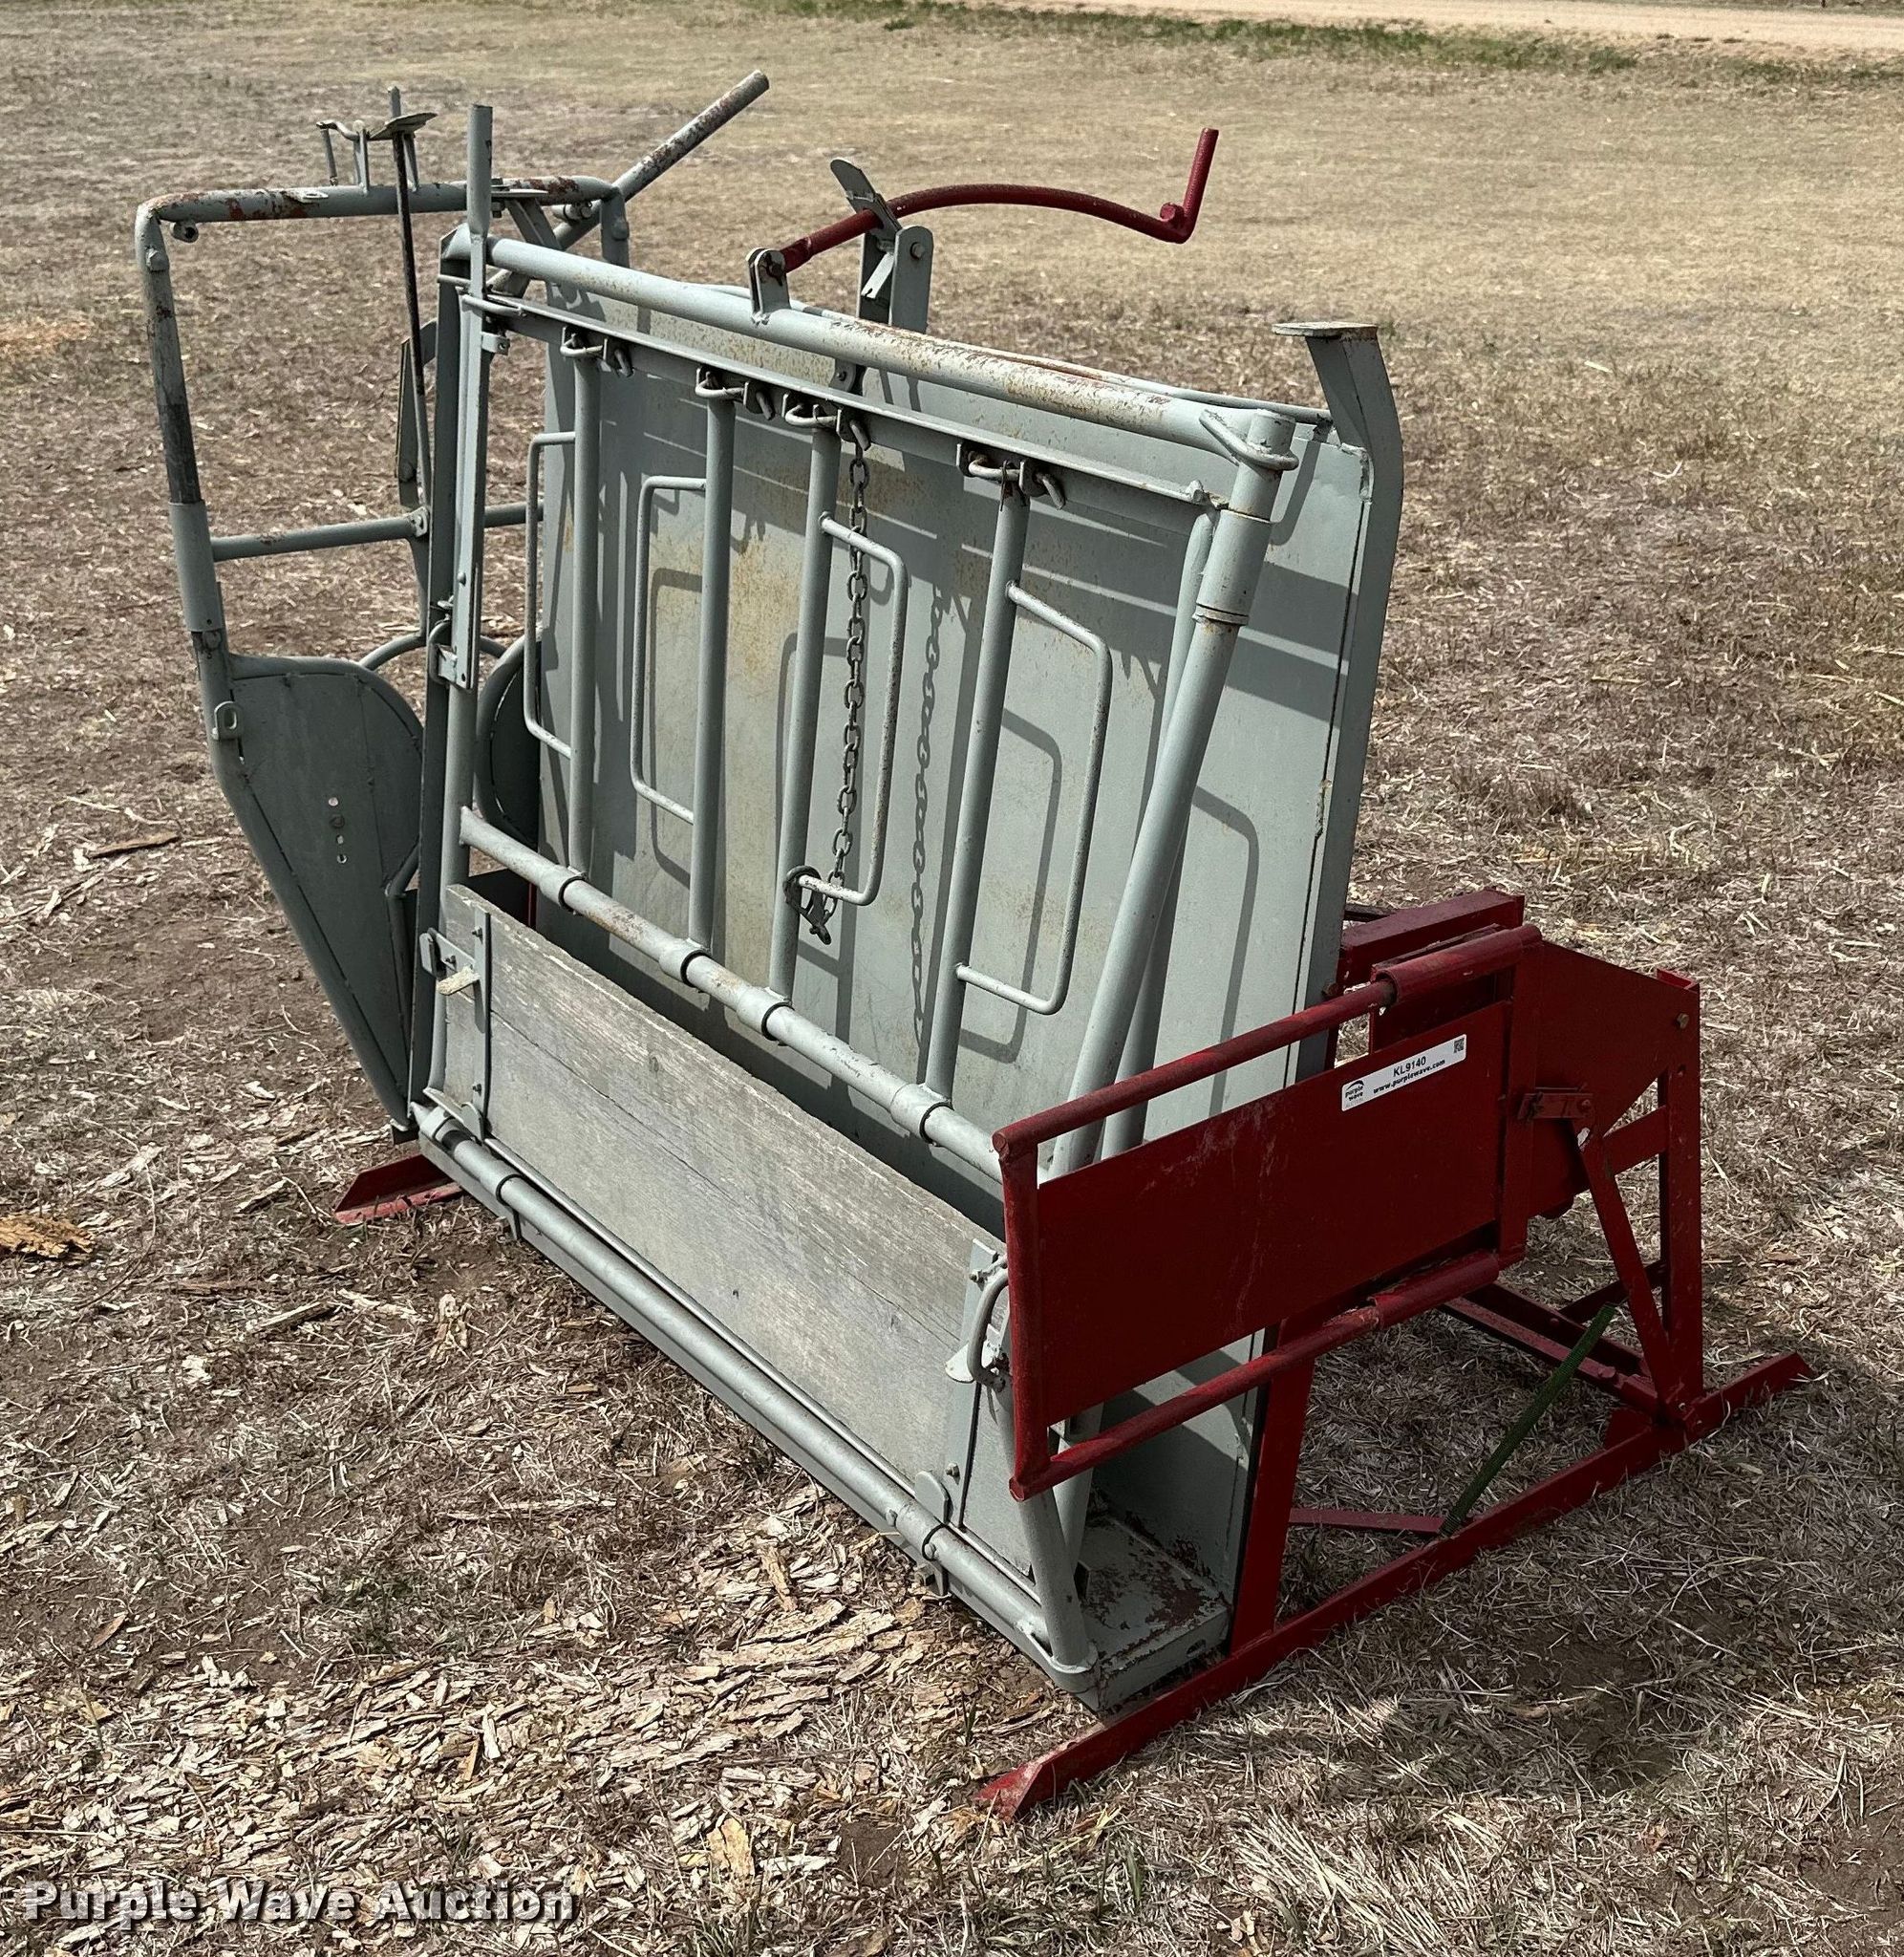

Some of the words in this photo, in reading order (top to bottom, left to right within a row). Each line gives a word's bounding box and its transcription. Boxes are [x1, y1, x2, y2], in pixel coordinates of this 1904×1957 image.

[1393, 1056, 1426, 1077] KL9140
[1374, 1060, 1445, 1093] www.purplewave.com
[1345, 1086, 1364, 1098] purple
[1349, 1091, 1363, 1101] wave
